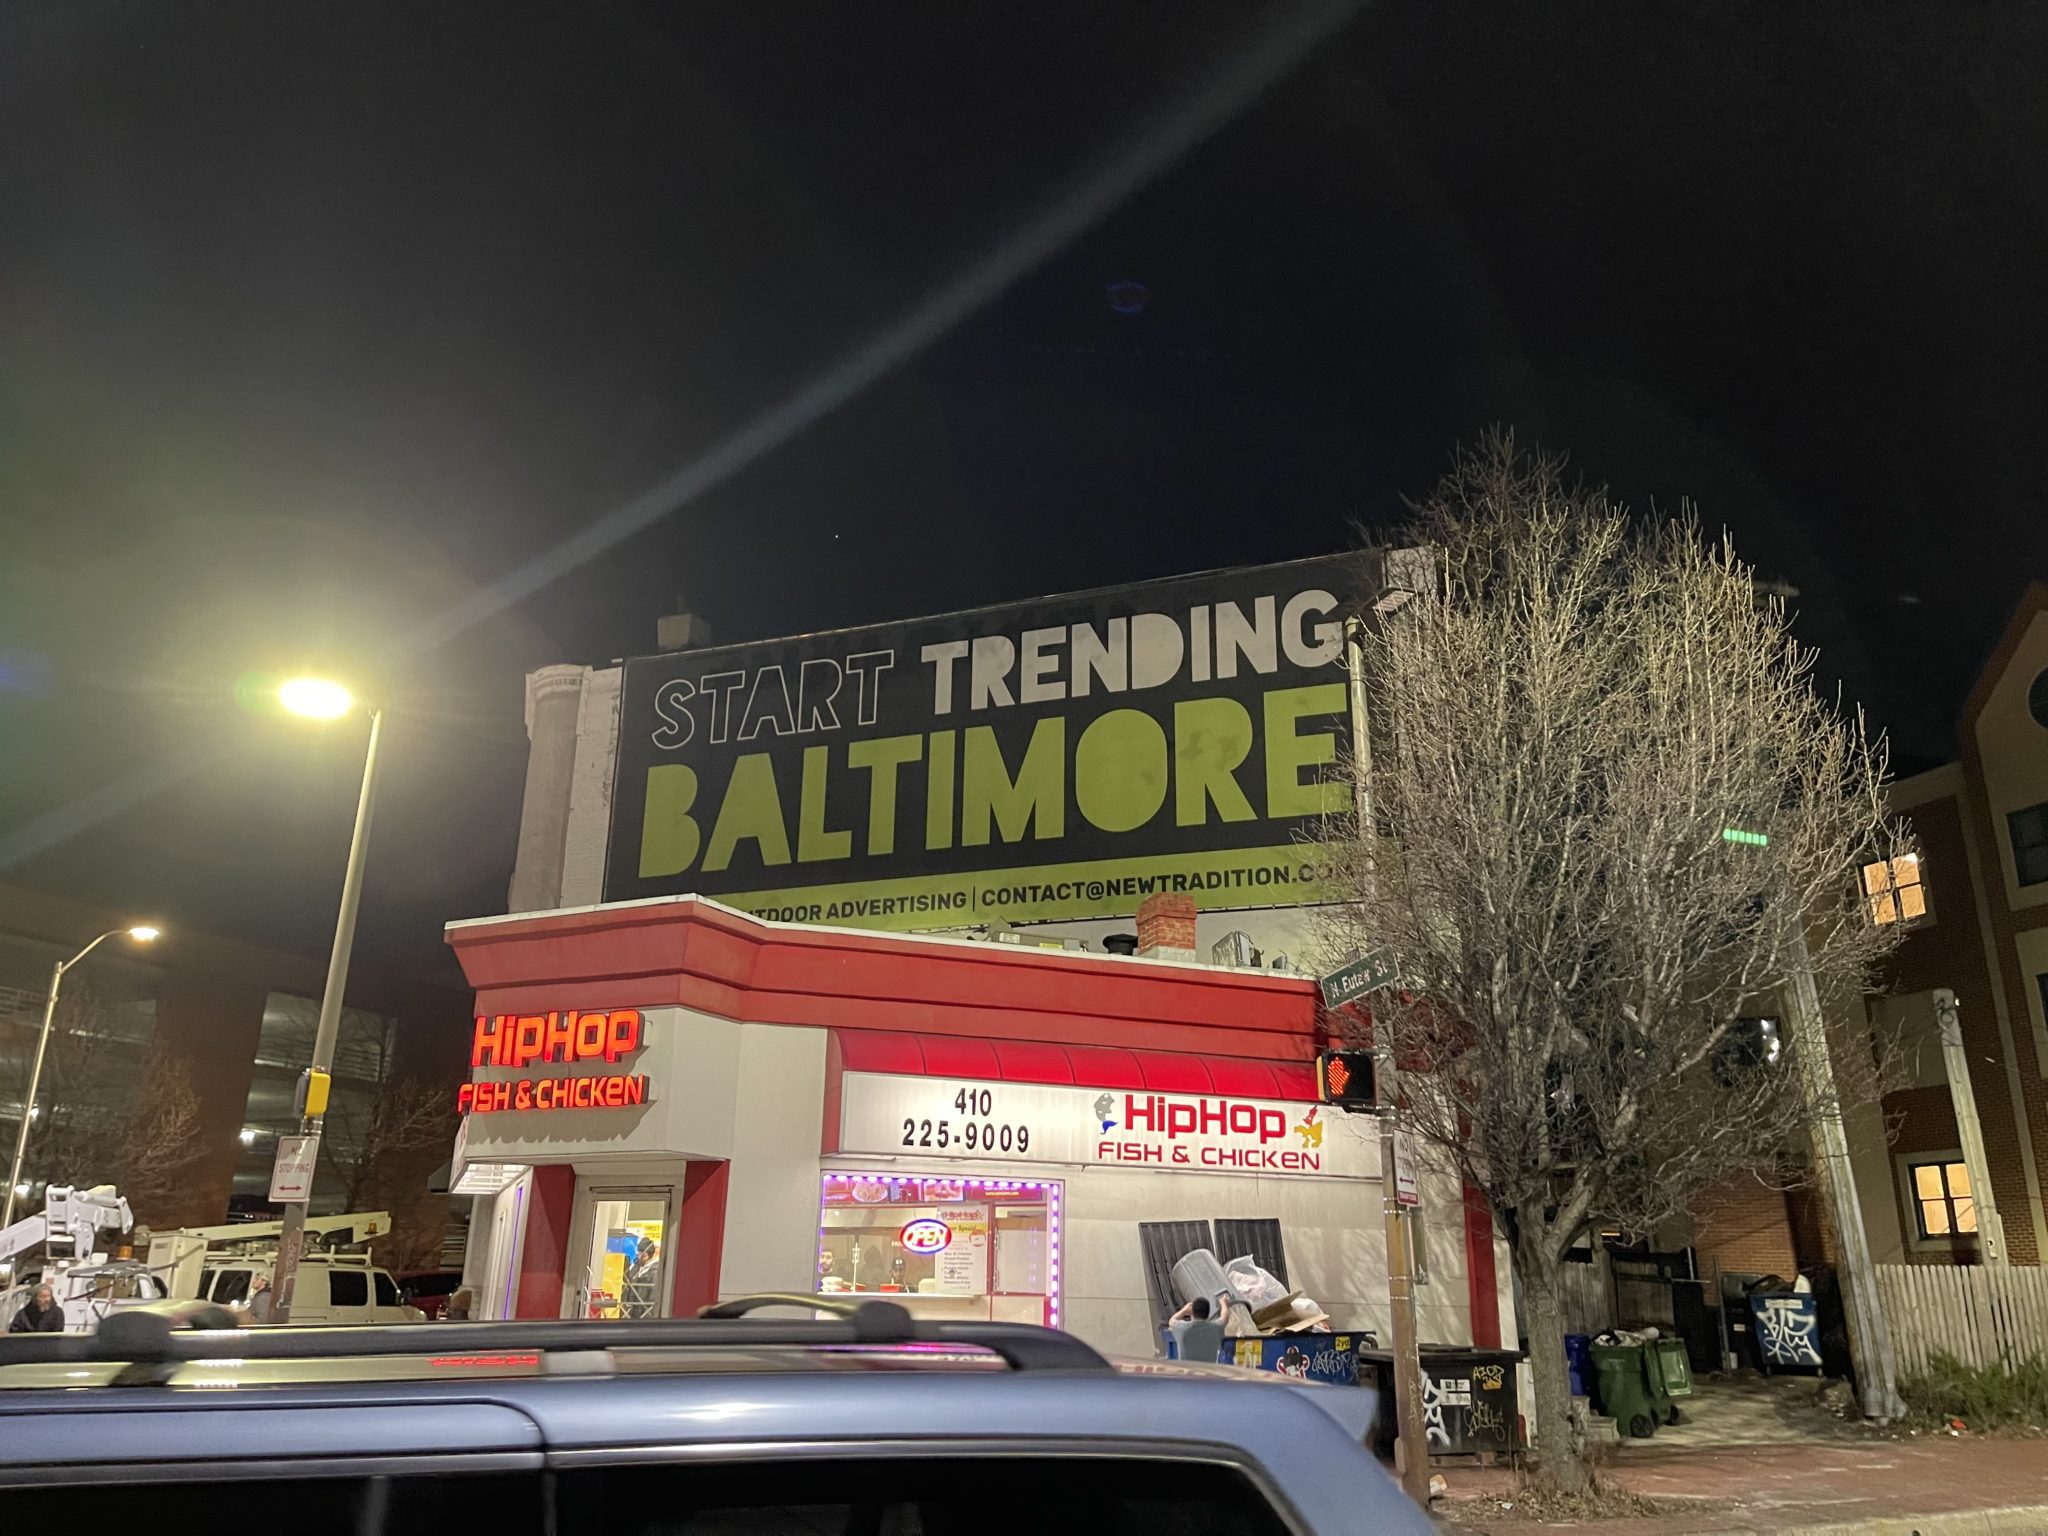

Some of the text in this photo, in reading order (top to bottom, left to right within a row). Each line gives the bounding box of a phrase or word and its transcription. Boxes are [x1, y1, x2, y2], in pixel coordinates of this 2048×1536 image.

[652, 589, 1345, 750] START TRENDING
[638, 682, 1352, 879] BALTIMORE
[825, 891, 967, 921] ADVERTISING
[1330, 981, 1340, 999] N
[1341, 969, 1371, 993] Eutaw
[457, 1082, 512, 1113] FISH
[514, 1080, 532, 1110] &
[954, 1087, 992, 1116] 410
[902, 1118, 1029, 1152] 225-9009
[1098, 1141, 1162, 1162] FISH
[1172, 1145, 1190, 1163] &
[903, 1226, 947, 1248] OPEN
